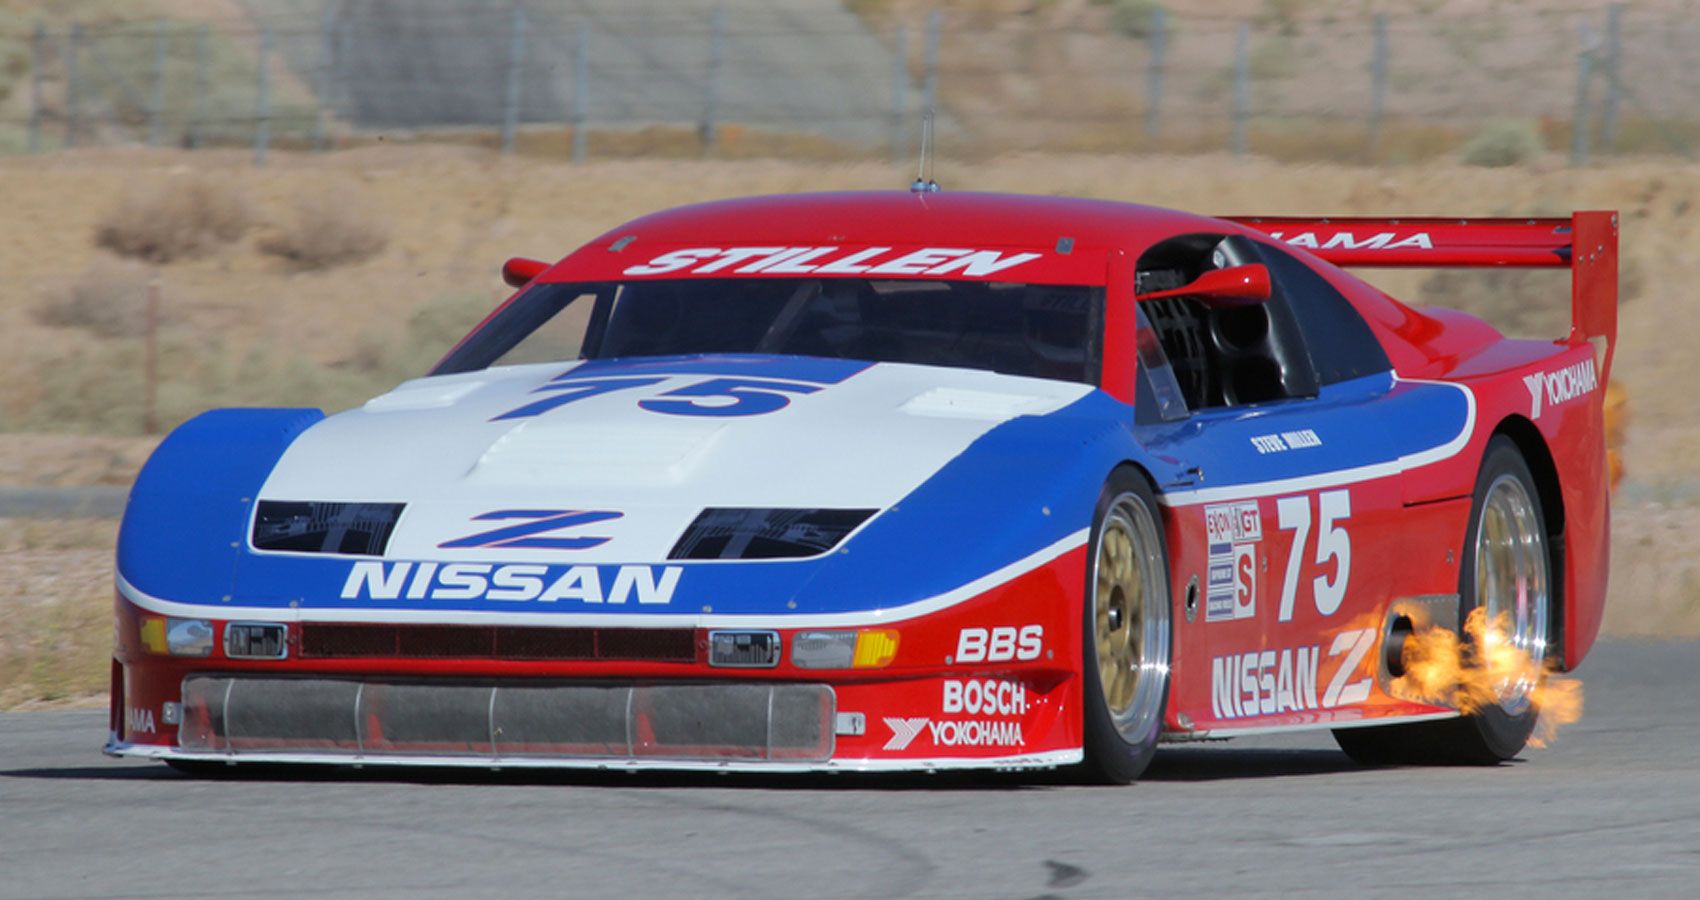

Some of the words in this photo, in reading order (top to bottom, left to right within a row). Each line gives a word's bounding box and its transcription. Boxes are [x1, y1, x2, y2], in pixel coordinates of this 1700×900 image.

[623, 246, 1043, 277] STILLEN
[488, 373, 826, 421] 75
[437, 509, 626, 550] Z
[1277, 488, 1351, 624] 75
[340, 561, 684, 605] NISSAN
[1238, 553, 1253, 609] S
[955, 624, 1044, 663] BBS
[1212, 646, 1320, 720] NISSAN
[1322, 627, 1378, 709] Z
[943, 679, 1026, 715] BOSCH
[928, 720, 1026, 747] YOKOHAMA
